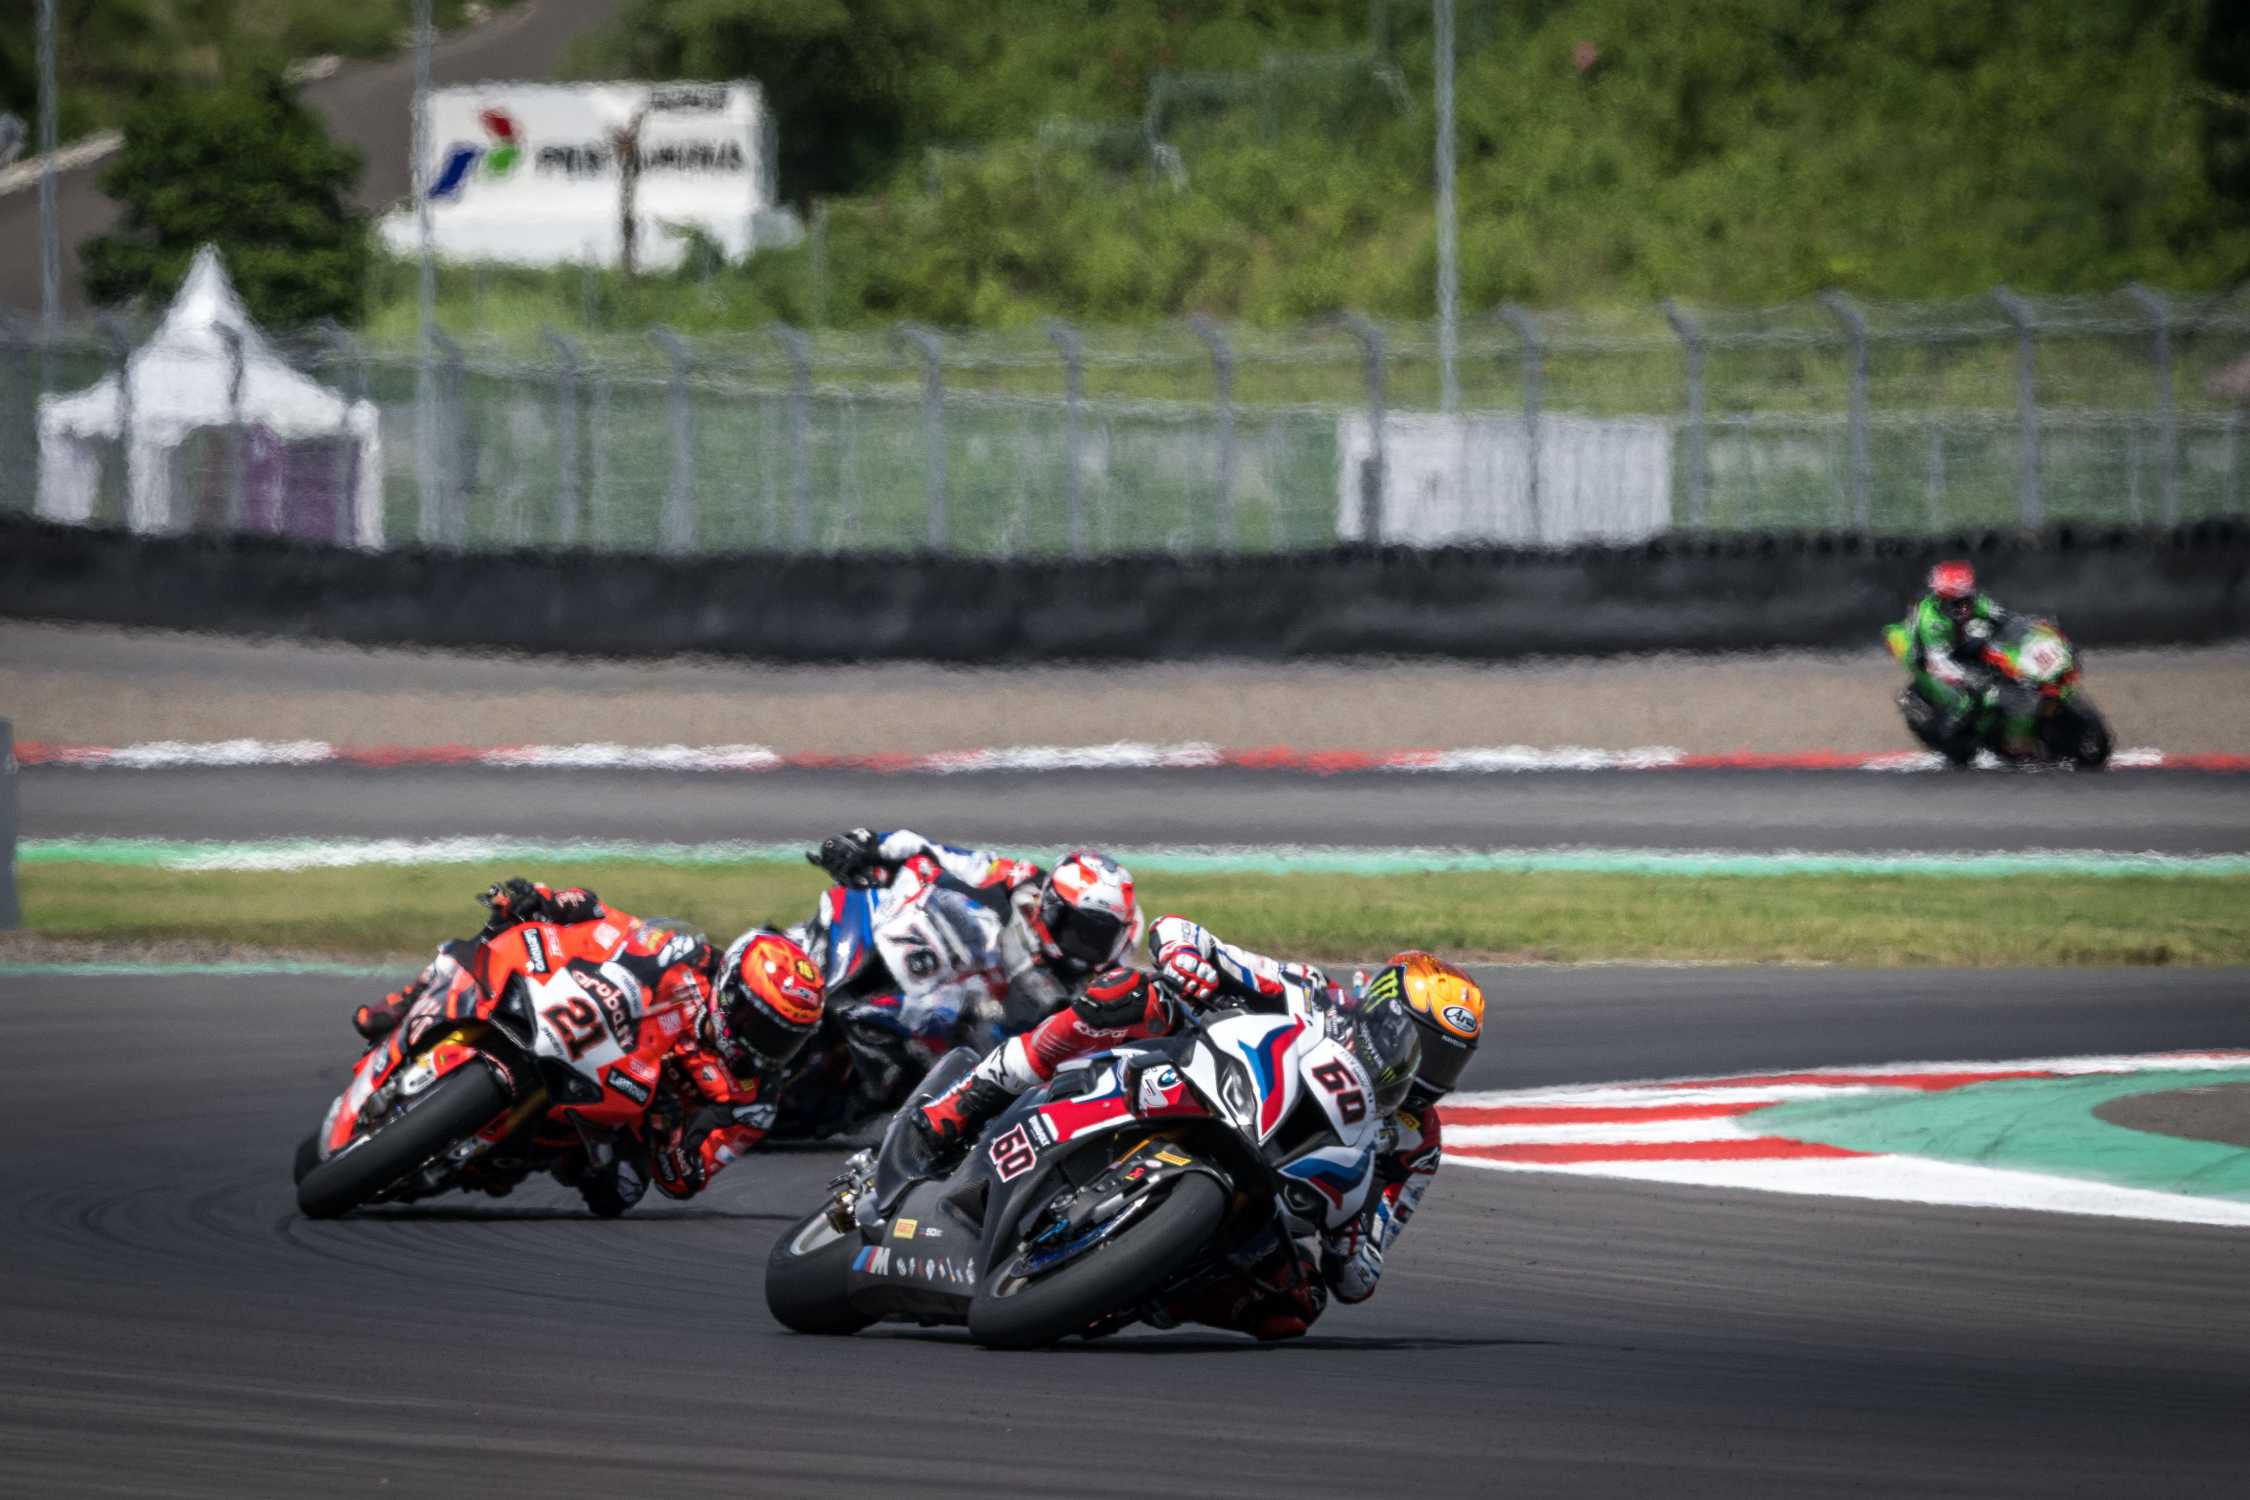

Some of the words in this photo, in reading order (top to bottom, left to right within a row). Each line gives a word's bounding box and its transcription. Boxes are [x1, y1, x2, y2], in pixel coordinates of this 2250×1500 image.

[542, 996, 609, 1062] 21
[1311, 1056, 1367, 1125] 60
[989, 1123, 1037, 1182] 60
